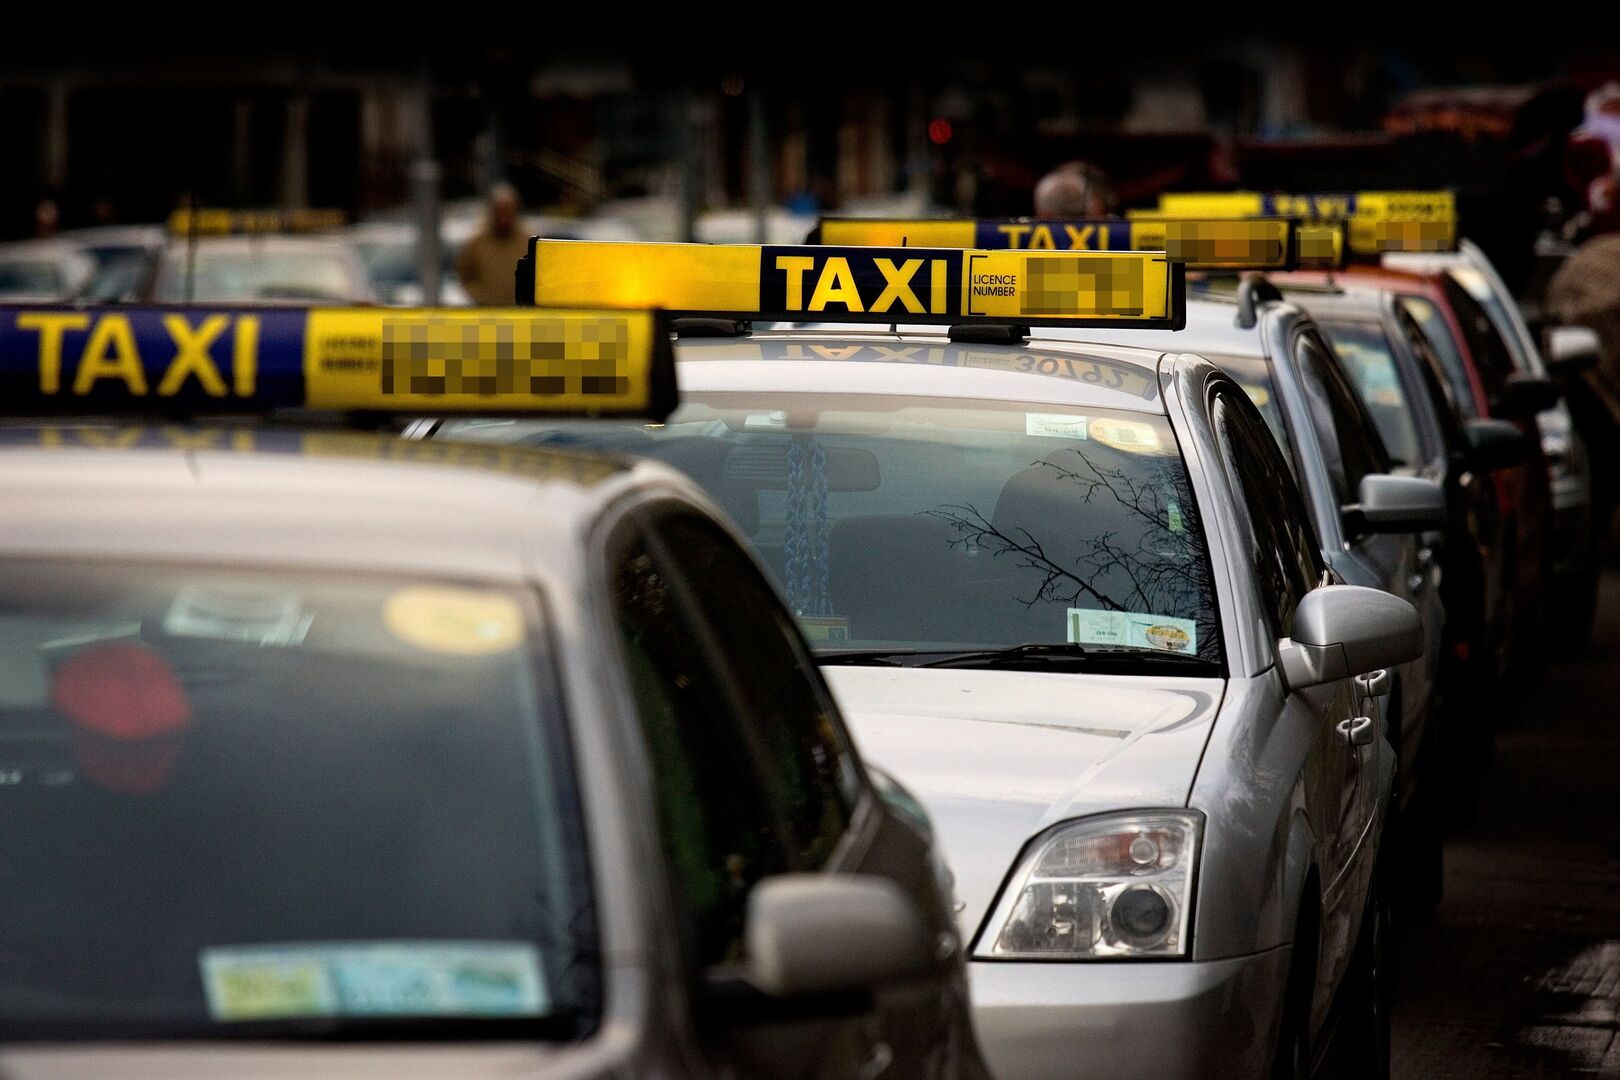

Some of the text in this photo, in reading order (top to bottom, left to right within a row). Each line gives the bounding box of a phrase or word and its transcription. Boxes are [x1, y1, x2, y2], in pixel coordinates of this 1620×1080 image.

[998, 225, 1109, 250] TAXI
[776, 256, 948, 314] TAXI
[973, 274, 1016, 285] LICENCE
[973, 286, 1016, 297] NUMBER
[16, 313, 259, 397] TAXI
